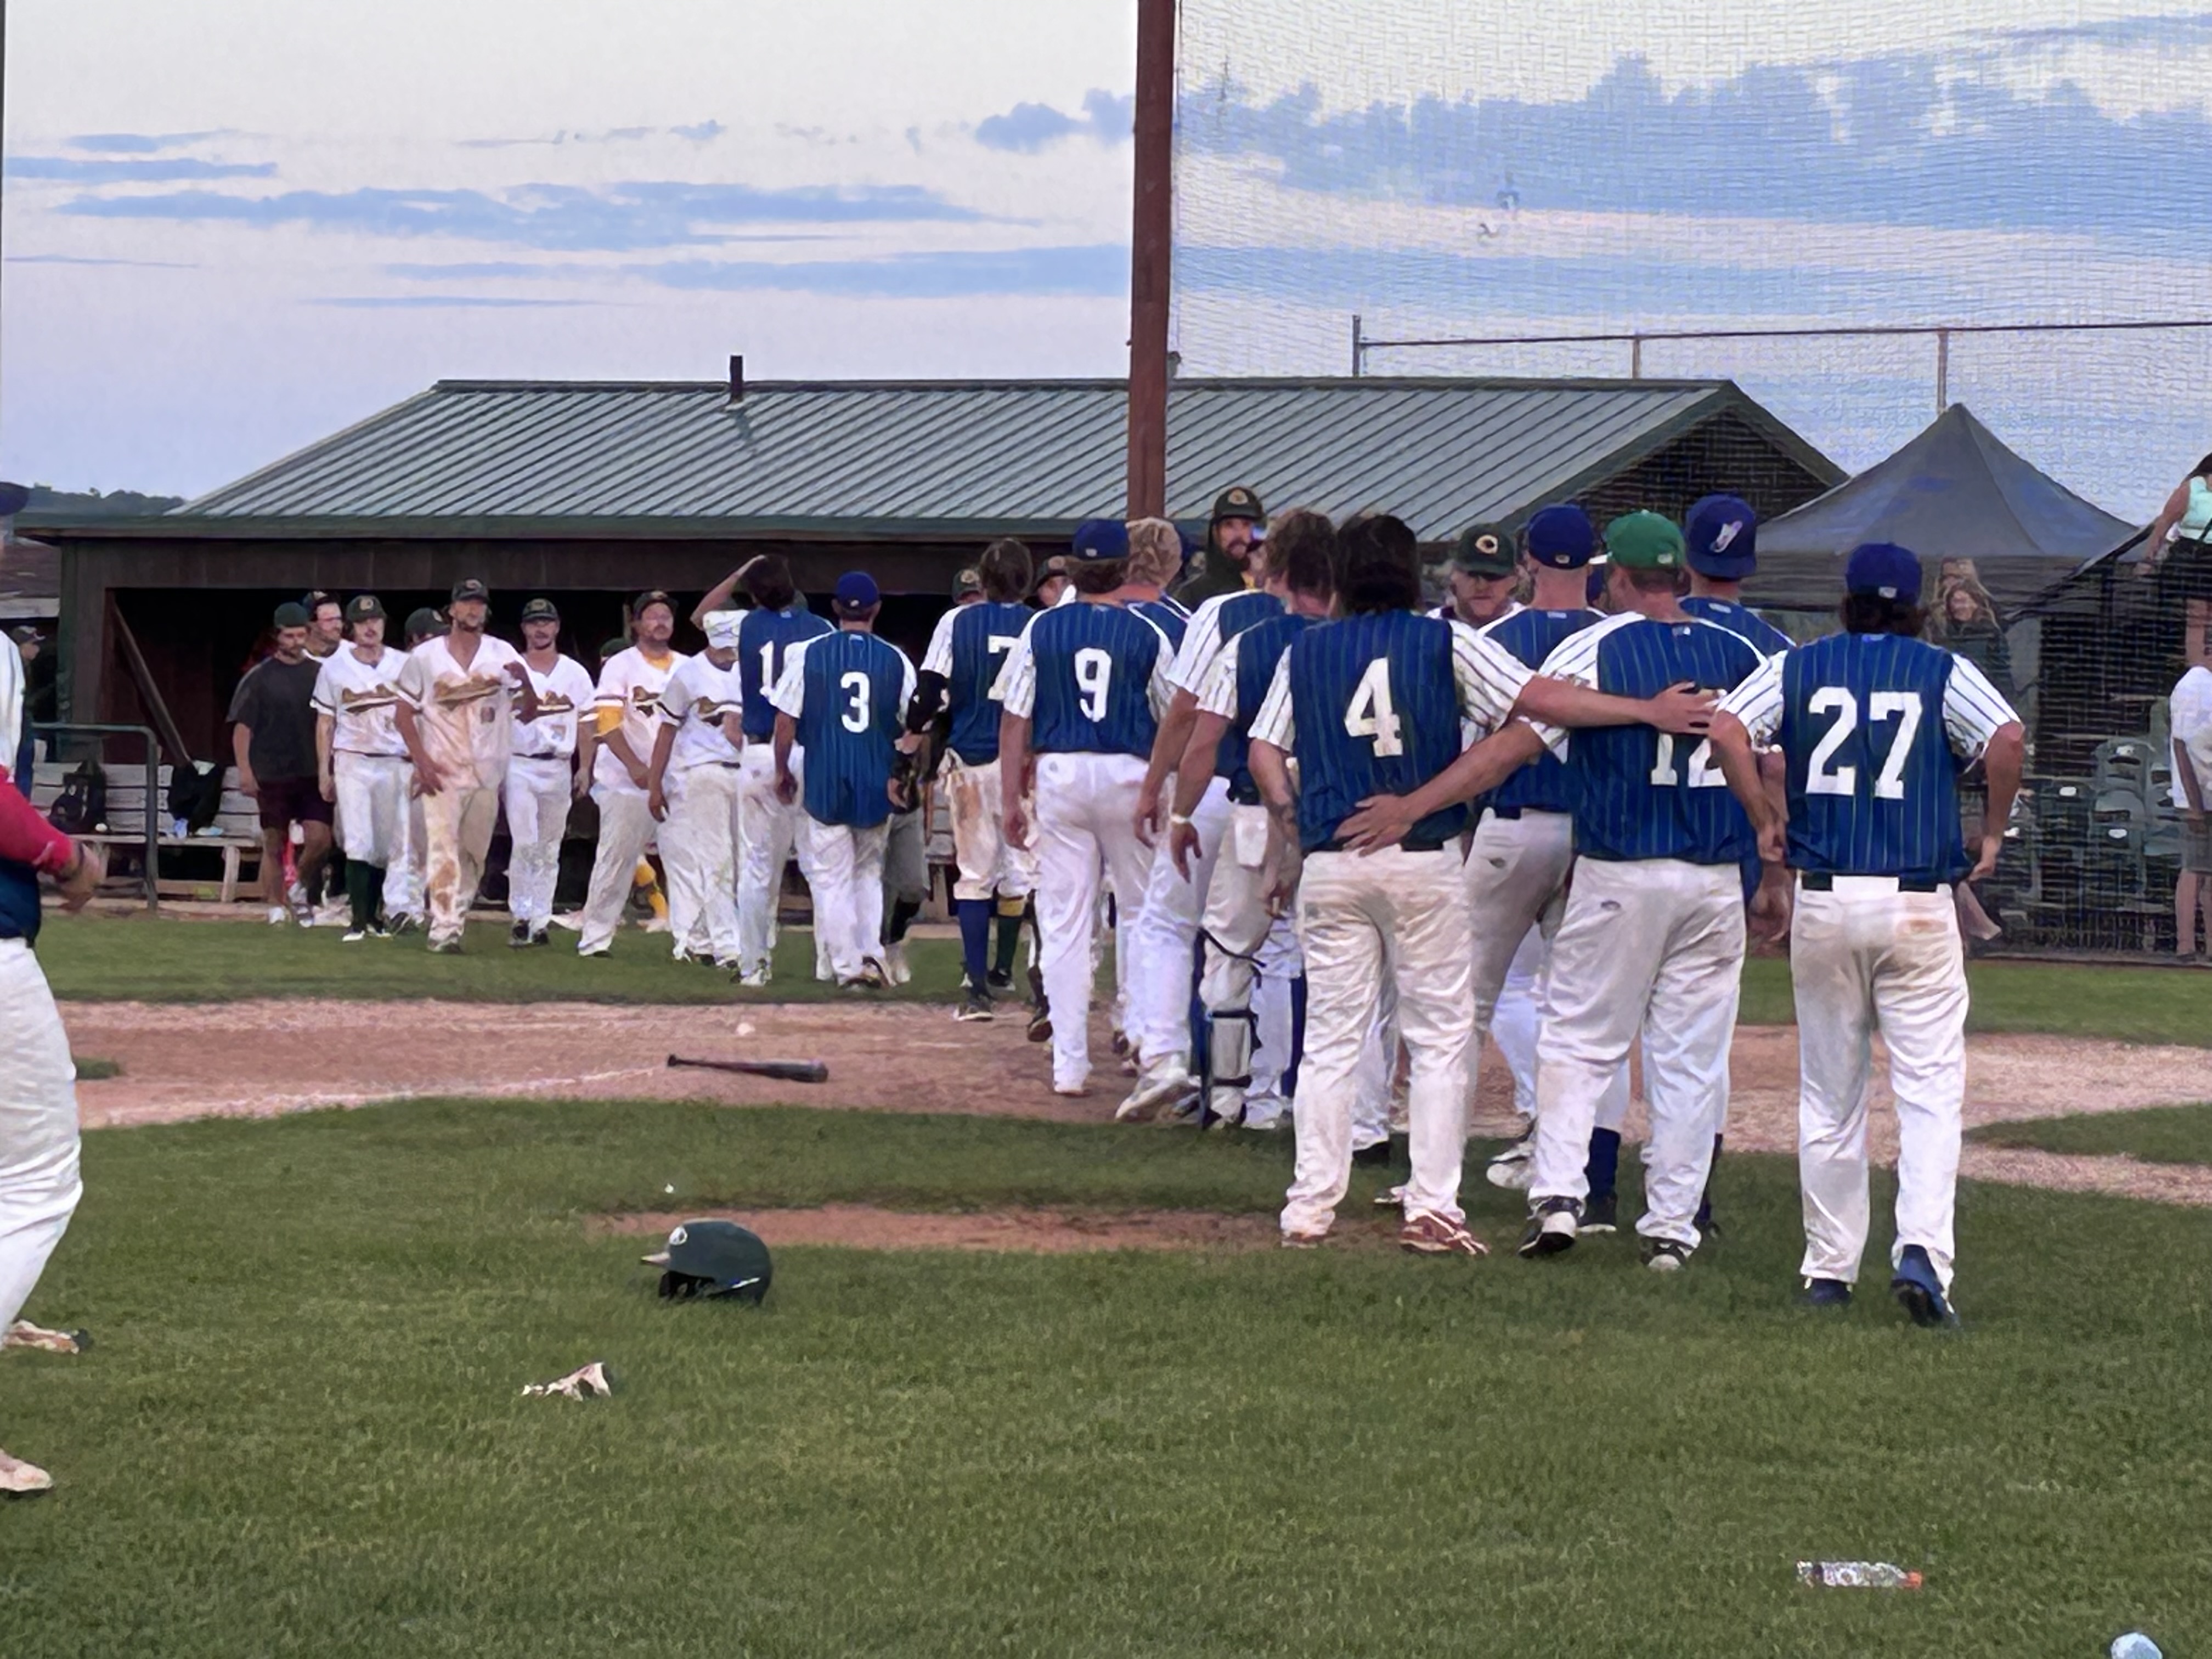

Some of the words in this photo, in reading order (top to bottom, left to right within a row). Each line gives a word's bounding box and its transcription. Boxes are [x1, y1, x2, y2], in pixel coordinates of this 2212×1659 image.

[841, 672, 870, 732] 3
[988, 635, 1020, 699] 7
[1075, 648, 1112, 722] 9
[1345, 657, 1403, 757] 4
[1806, 686, 1922, 799] 27
